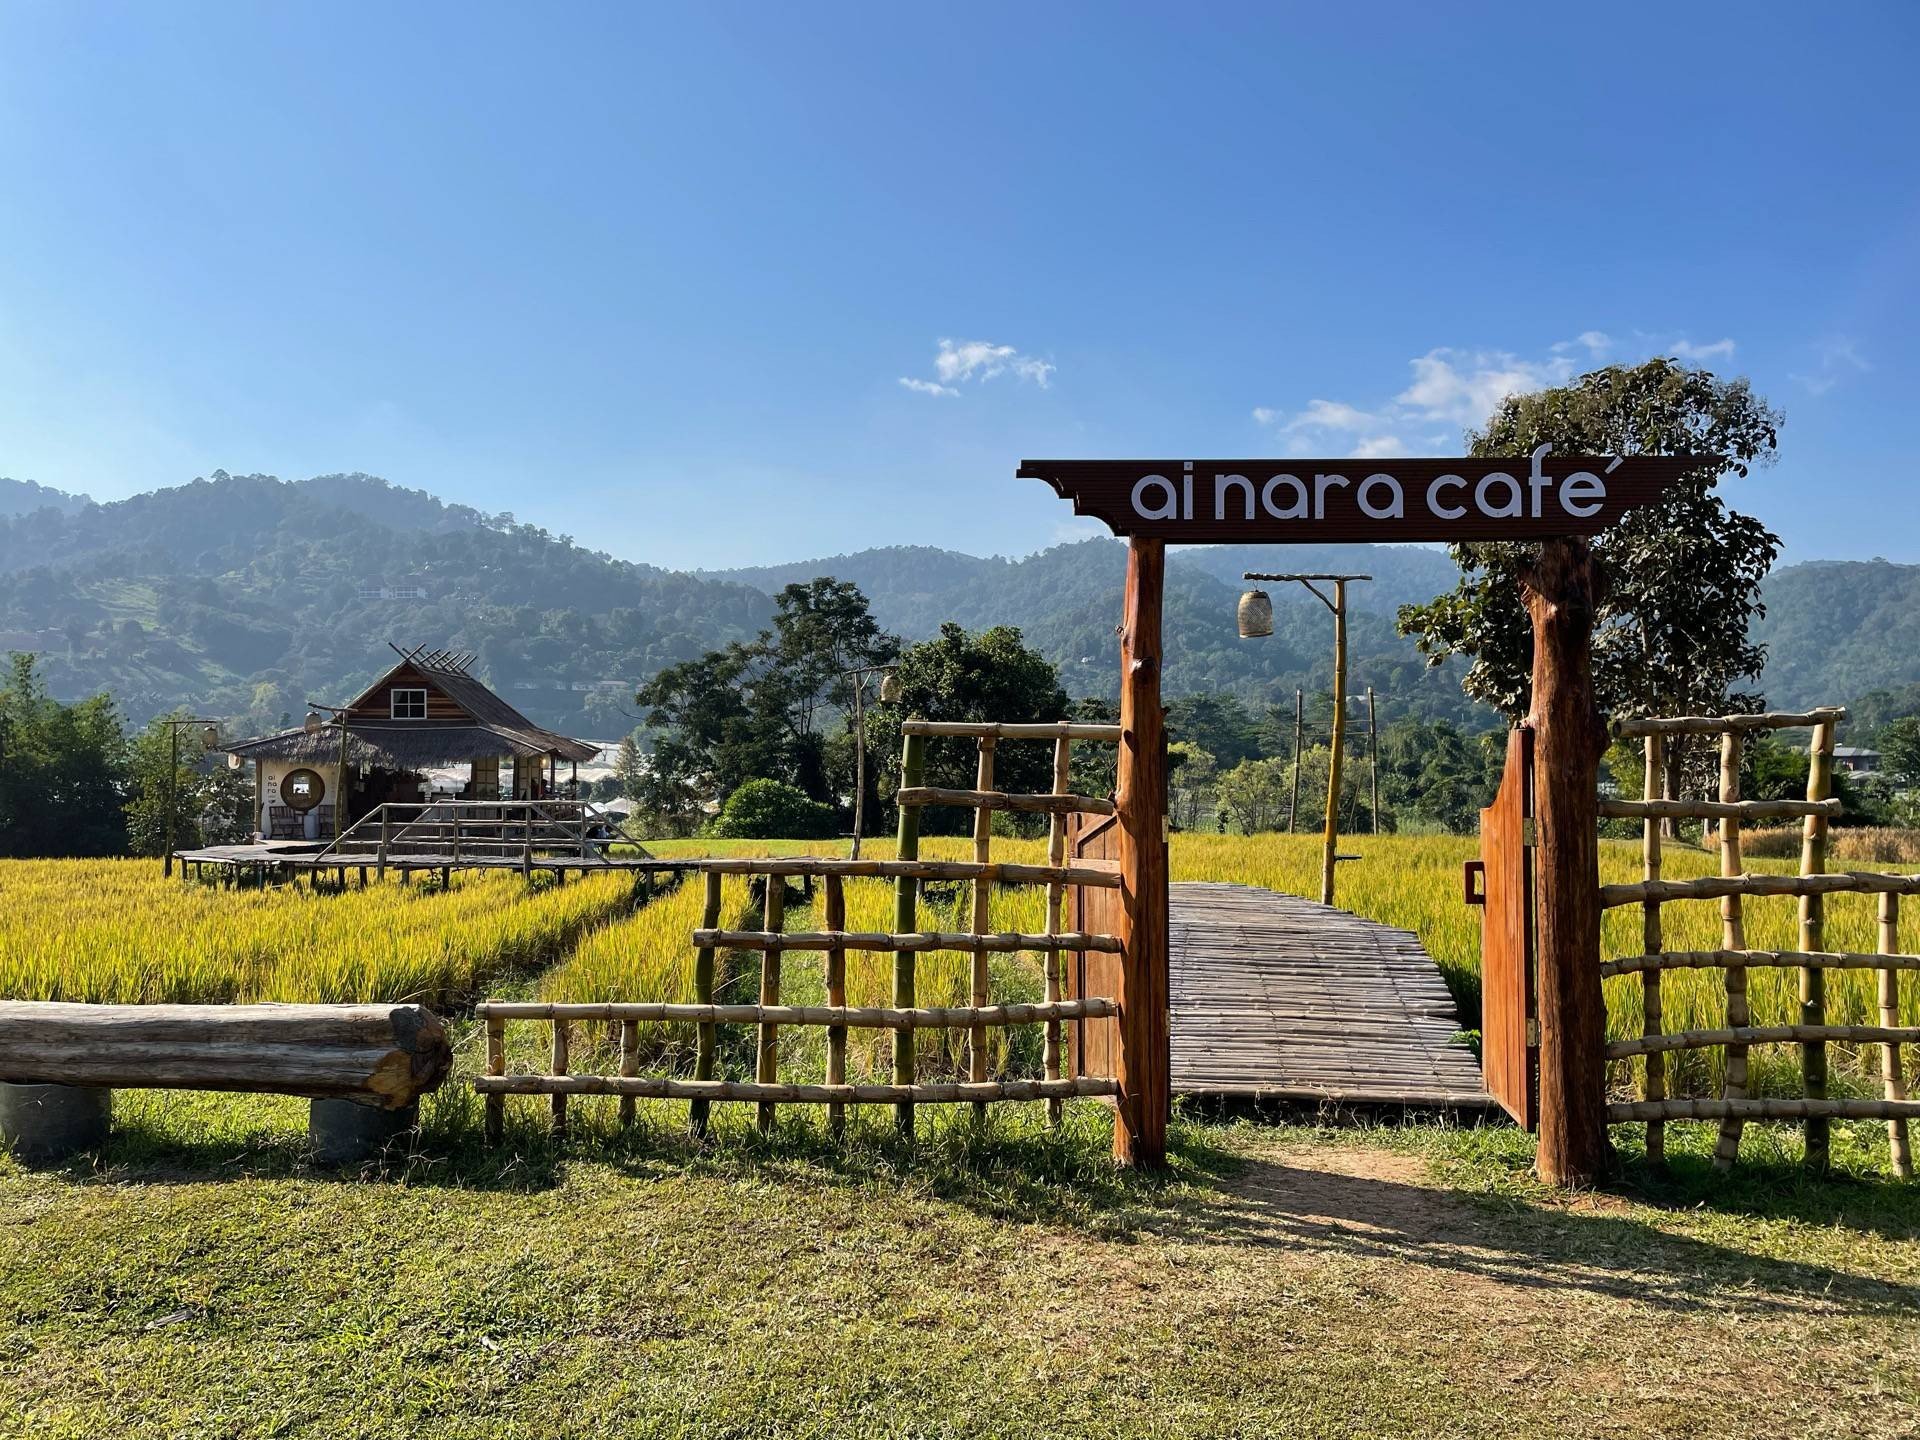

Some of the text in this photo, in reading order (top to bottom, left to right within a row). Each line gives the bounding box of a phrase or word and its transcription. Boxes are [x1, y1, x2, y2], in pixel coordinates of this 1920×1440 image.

[1131, 442, 1624, 520] ai nara café
